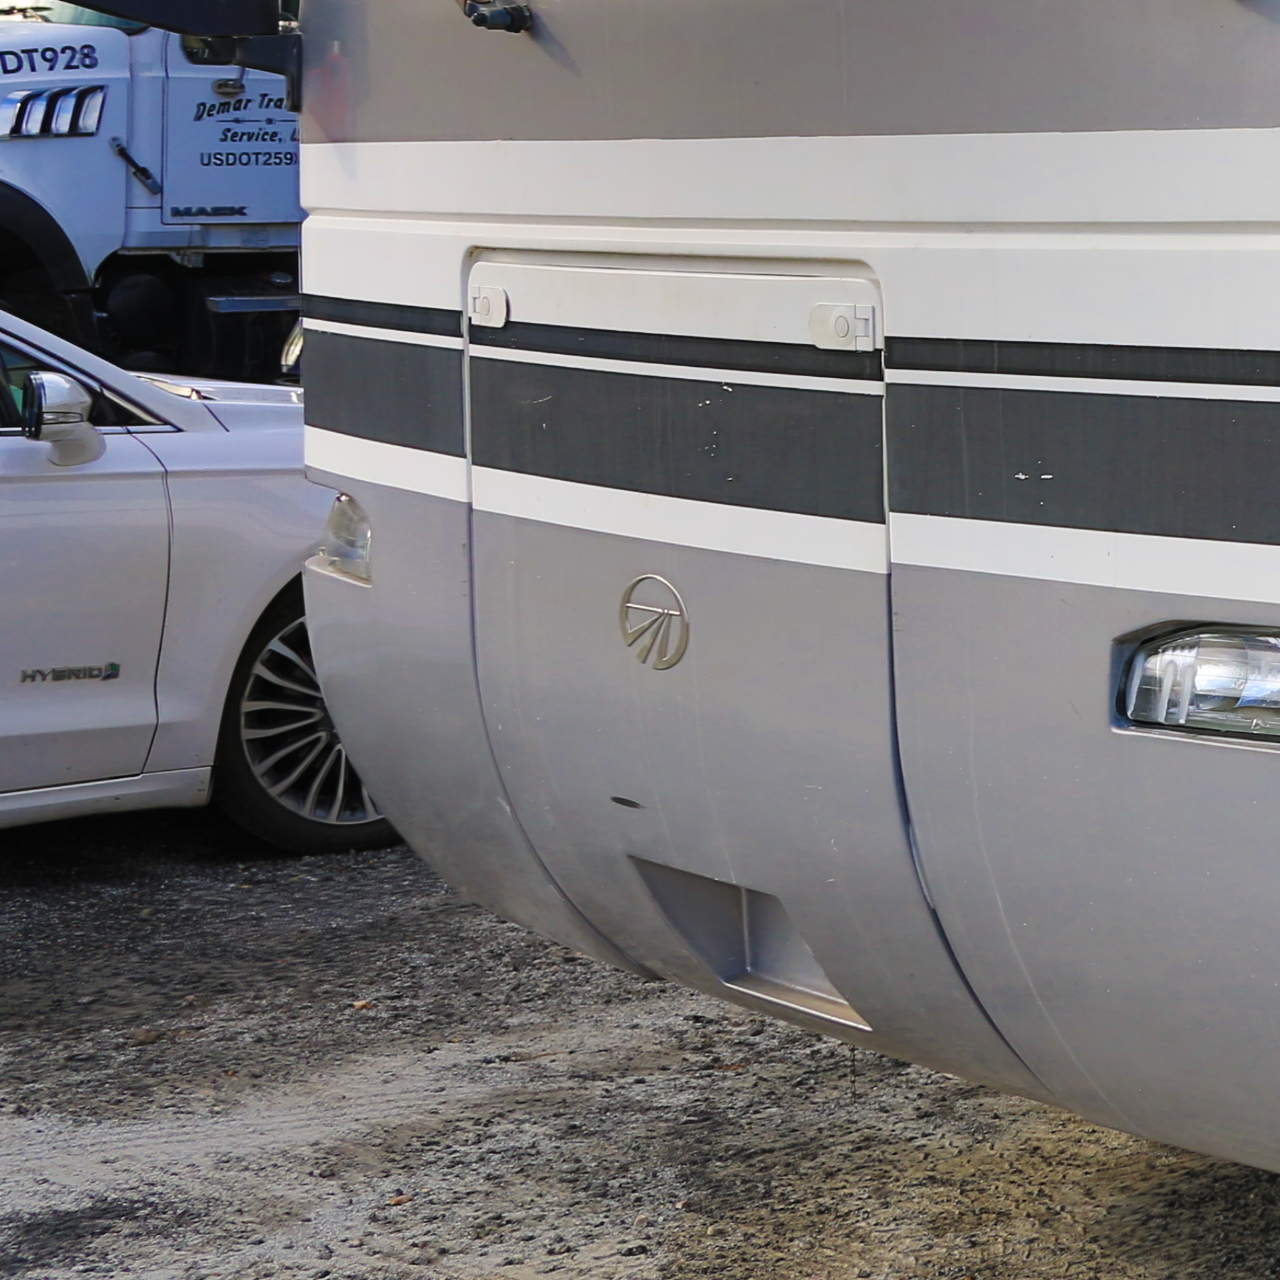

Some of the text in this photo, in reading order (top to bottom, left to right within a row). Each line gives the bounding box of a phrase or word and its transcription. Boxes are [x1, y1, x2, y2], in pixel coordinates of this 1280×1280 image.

[0, 43, 99, 75] DT928
[193, 92, 287, 122] Demar Tra
[219, 127, 283, 144] Service,
[170, 205, 248, 217] MACK
[20, 666, 103, 683] HYBRID
